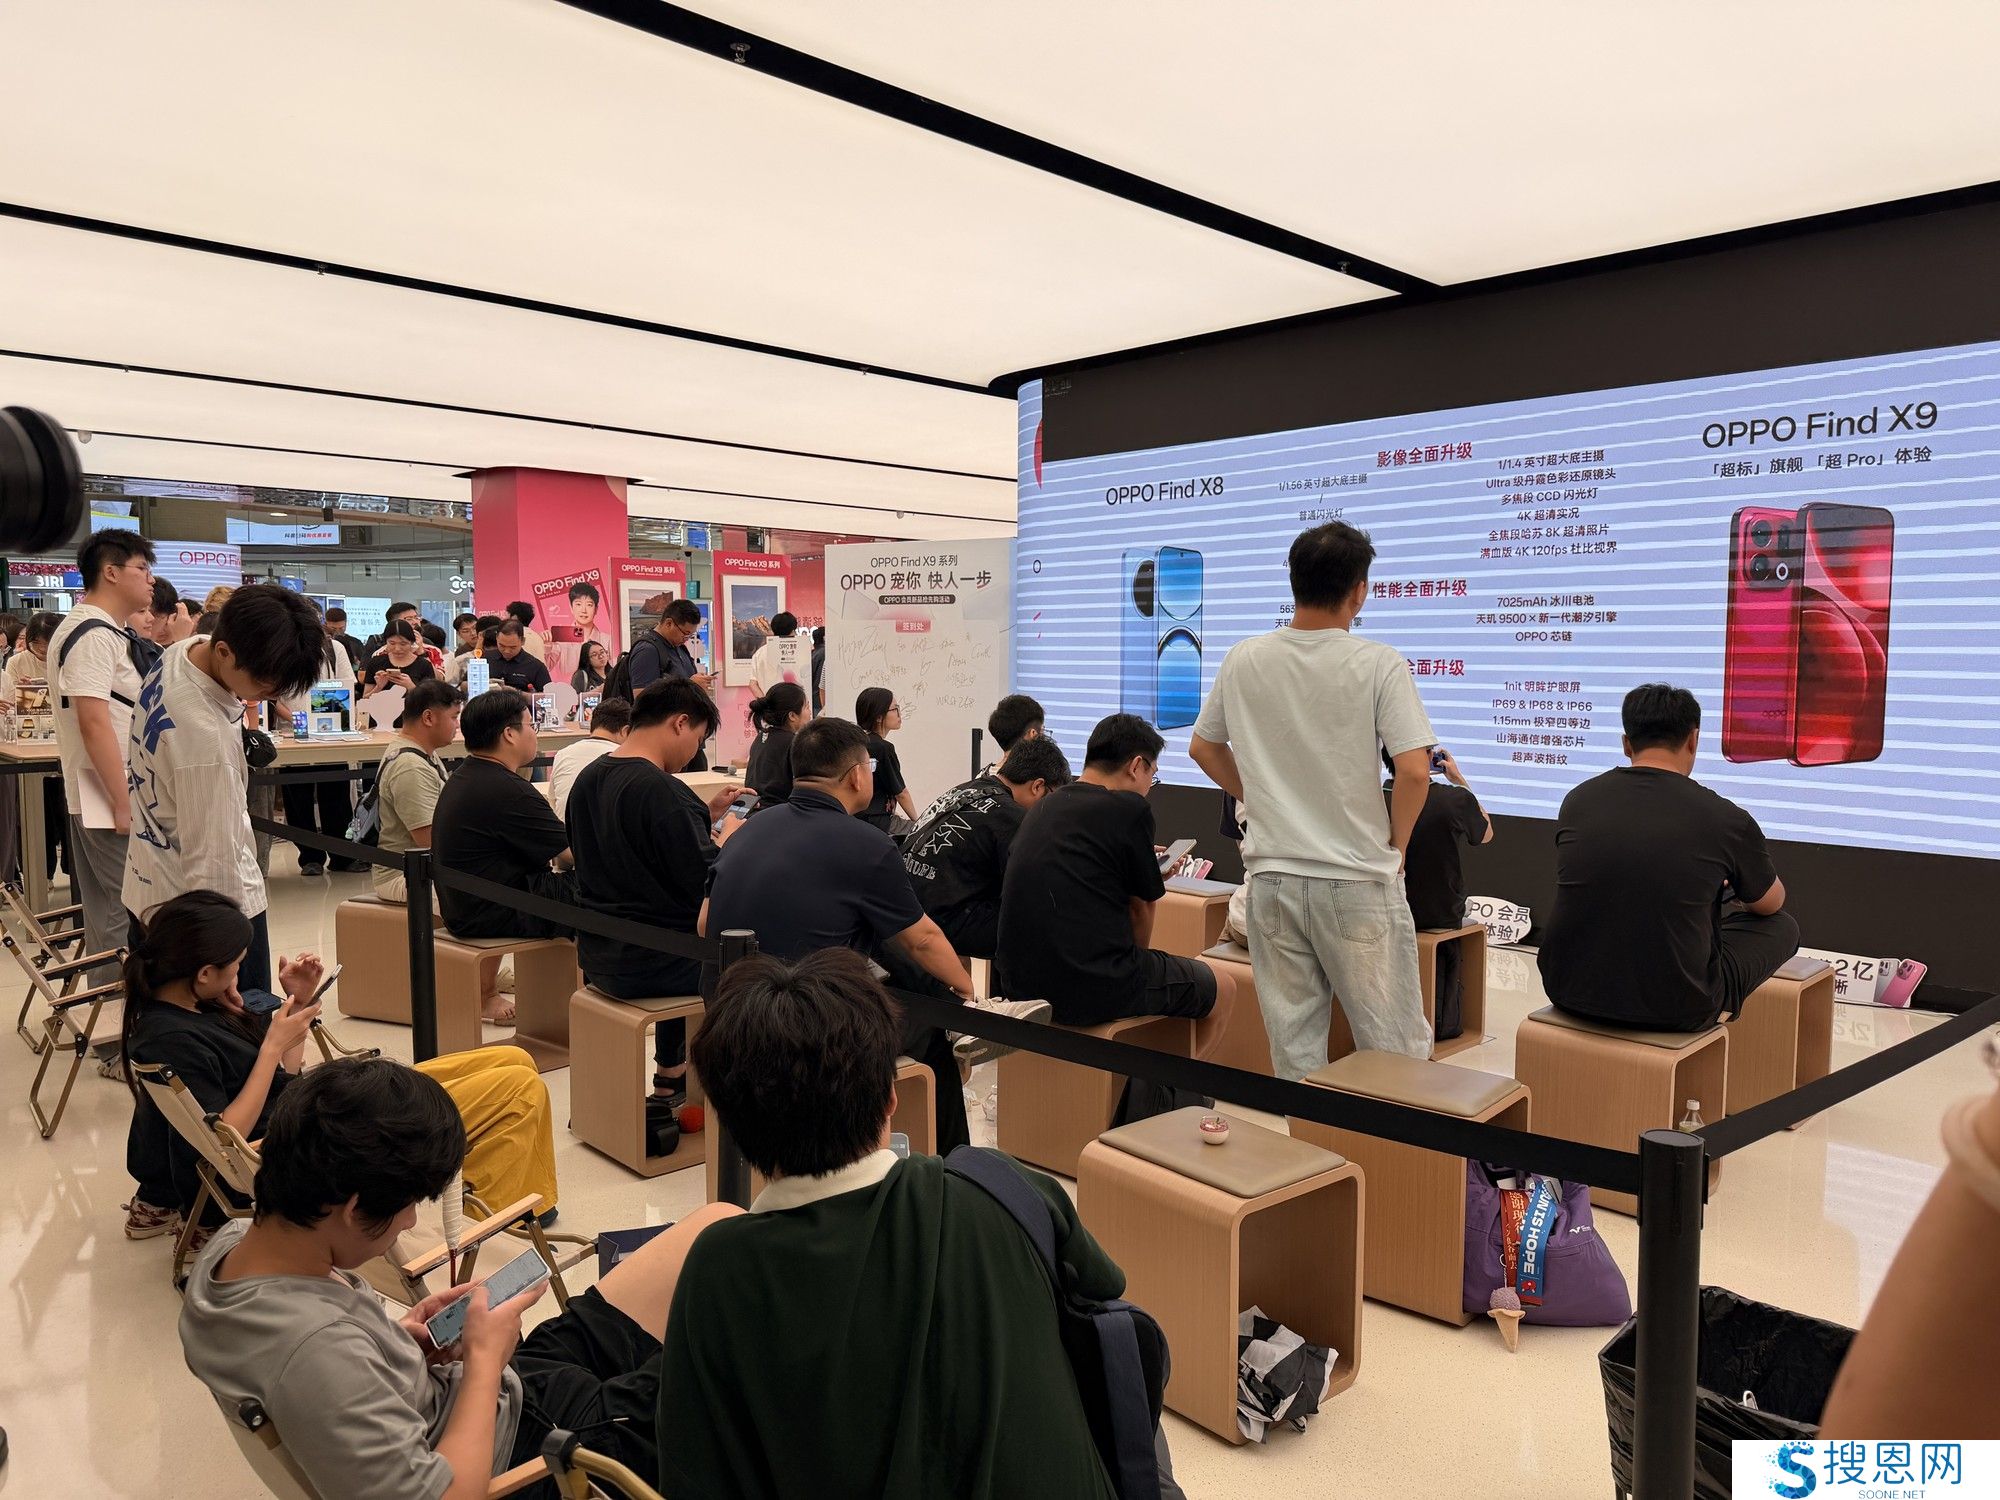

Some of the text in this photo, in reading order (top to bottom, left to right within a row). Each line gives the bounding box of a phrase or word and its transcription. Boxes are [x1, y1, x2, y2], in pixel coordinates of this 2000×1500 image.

[1703, 401, 1938, 448] OPPO Find X9
[1377, 442, 1473, 468] 影像全面升级
[1499, 449, 1604, 470] 1/1.4 英寸超大底主摄
[1769, 456, 1803, 475] 旗舰
[1894, 445, 1932, 465] 体验
[1303, 473, 1368, 490] 英寸超大底主摄
[1486, 477, 1511, 489] Ultra
[1106, 476, 1225, 507] OPPO Find X8
[1501, 487, 1598, 506] 多焦段 CCD 闪光灯
[1517, 507, 1580, 522] 4K 超清实况
[1488, 523, 1609, 542] 全焦段哈苏 8K 超清照片
[1480, 541, 1617, 560] 满血版 4K 120fps 杜比视界
[179, 551, 227, 566] OPPO
[724, 557, 744, 567] OPPO
[744, 559, 758, 568] Find
[870, 555, 958, 568] OPPO Find X9 系列
[621, 564, 640, 572] OPPO
[640, 565, 653, 573] Find
[534, 578, 564, 595] OPPO
[564, 573, 586, 587] Find
[585, 569, 600, 583] X9
[840, 570, 991, 591] OPPO 宠你 快人一步
[1372, 579, 1468, 599] 性能全面升级
[883, 596, 901, 604] OPPO
[1497, 594, 1595, 608] 7025mAh 冰川电池
[1476, 613, 1496, 625] 天玑
[1499, 612, 1526, 624] 9500
[1538, 611, 1617, 624] 新一代潮汐引擎
[1515, 631, 1572, 643] OPPO 芯链
[1504, 681, 1581, 694] 1nit 明眸护眼屏
[1492, 699, 1593, 712] IP69 & IP68 & IP66
[1493, 716, 1591, 730] 1.15mm 极窄四等边
[1496, 733, 1586, 748] 山海通信增强芯片
[1511, 751, 1569, 766] 超声波指纹
[1498, 905, 1529, 924] 会员
